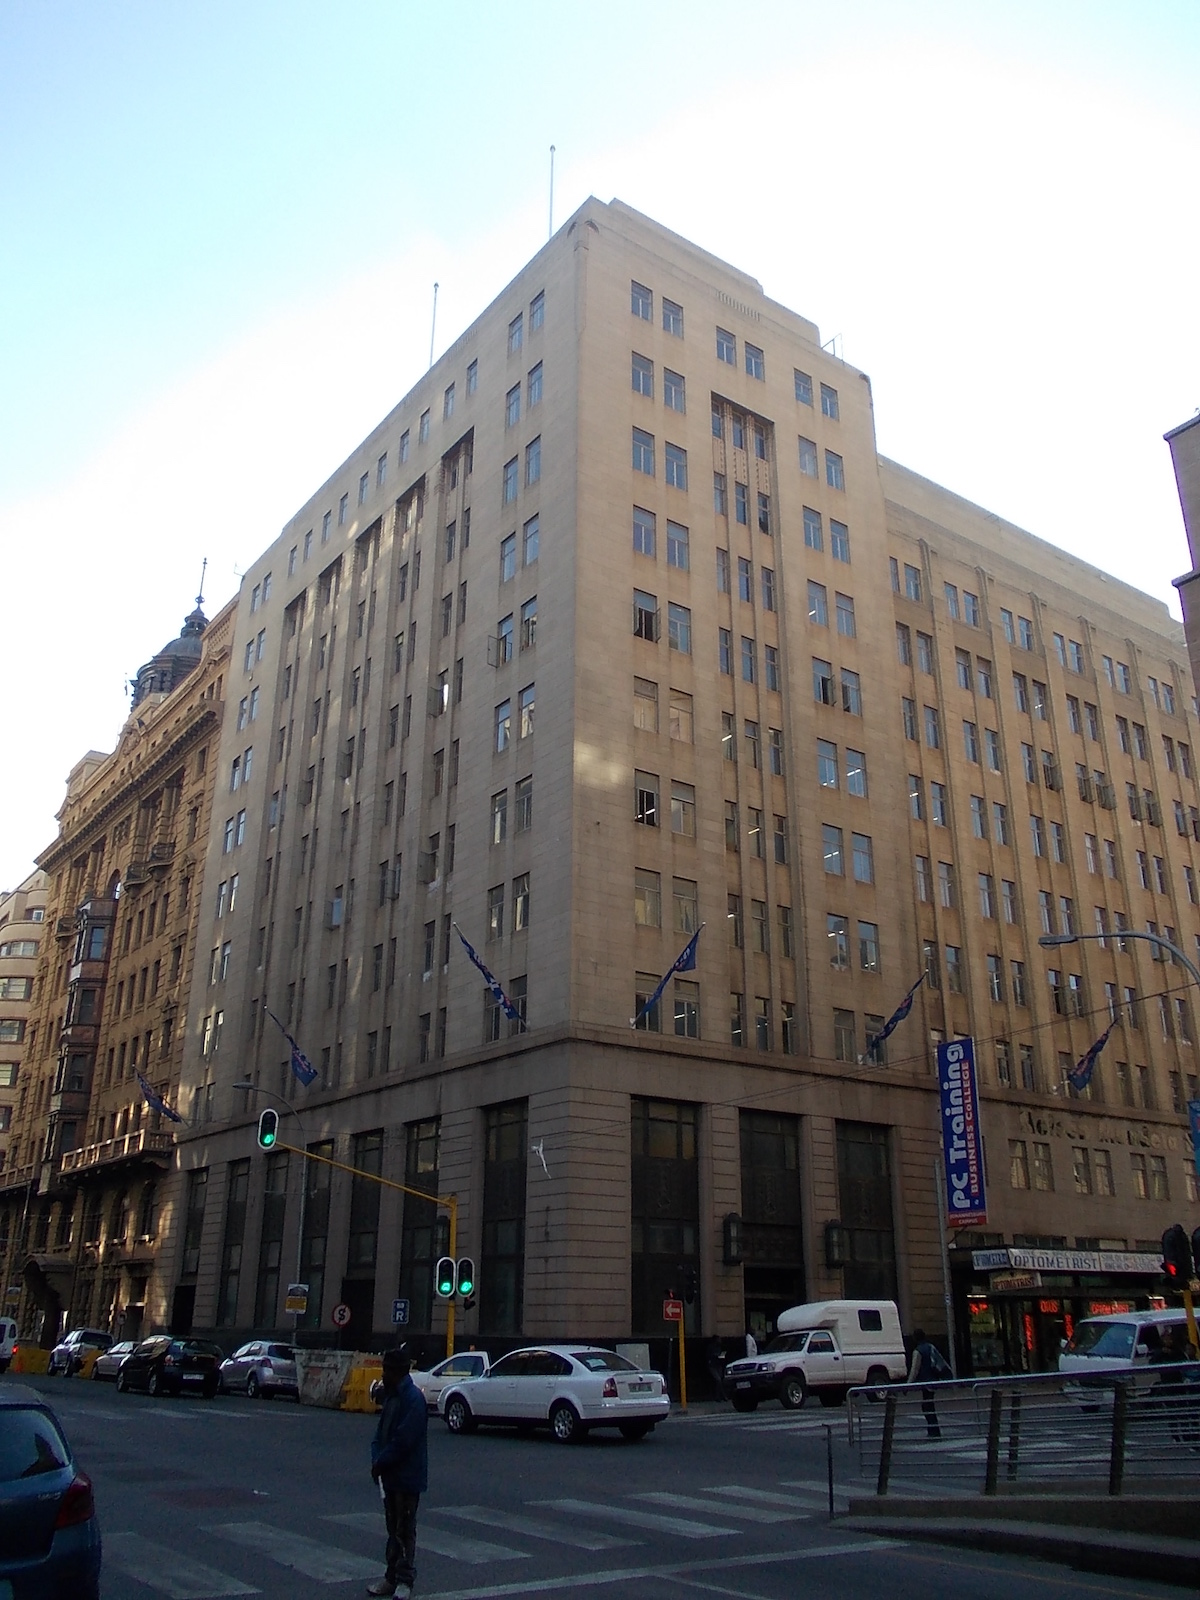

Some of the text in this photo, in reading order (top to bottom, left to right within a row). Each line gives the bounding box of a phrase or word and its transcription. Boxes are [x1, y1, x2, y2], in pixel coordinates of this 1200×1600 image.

[943, 1043, 971, 1209] PC Training
[966, 1124, 979, 1194] BUSINESS
[1014, 1255, 1098, 1270] OPTOMETRIST
[396, 1311, 404, 1322] R
